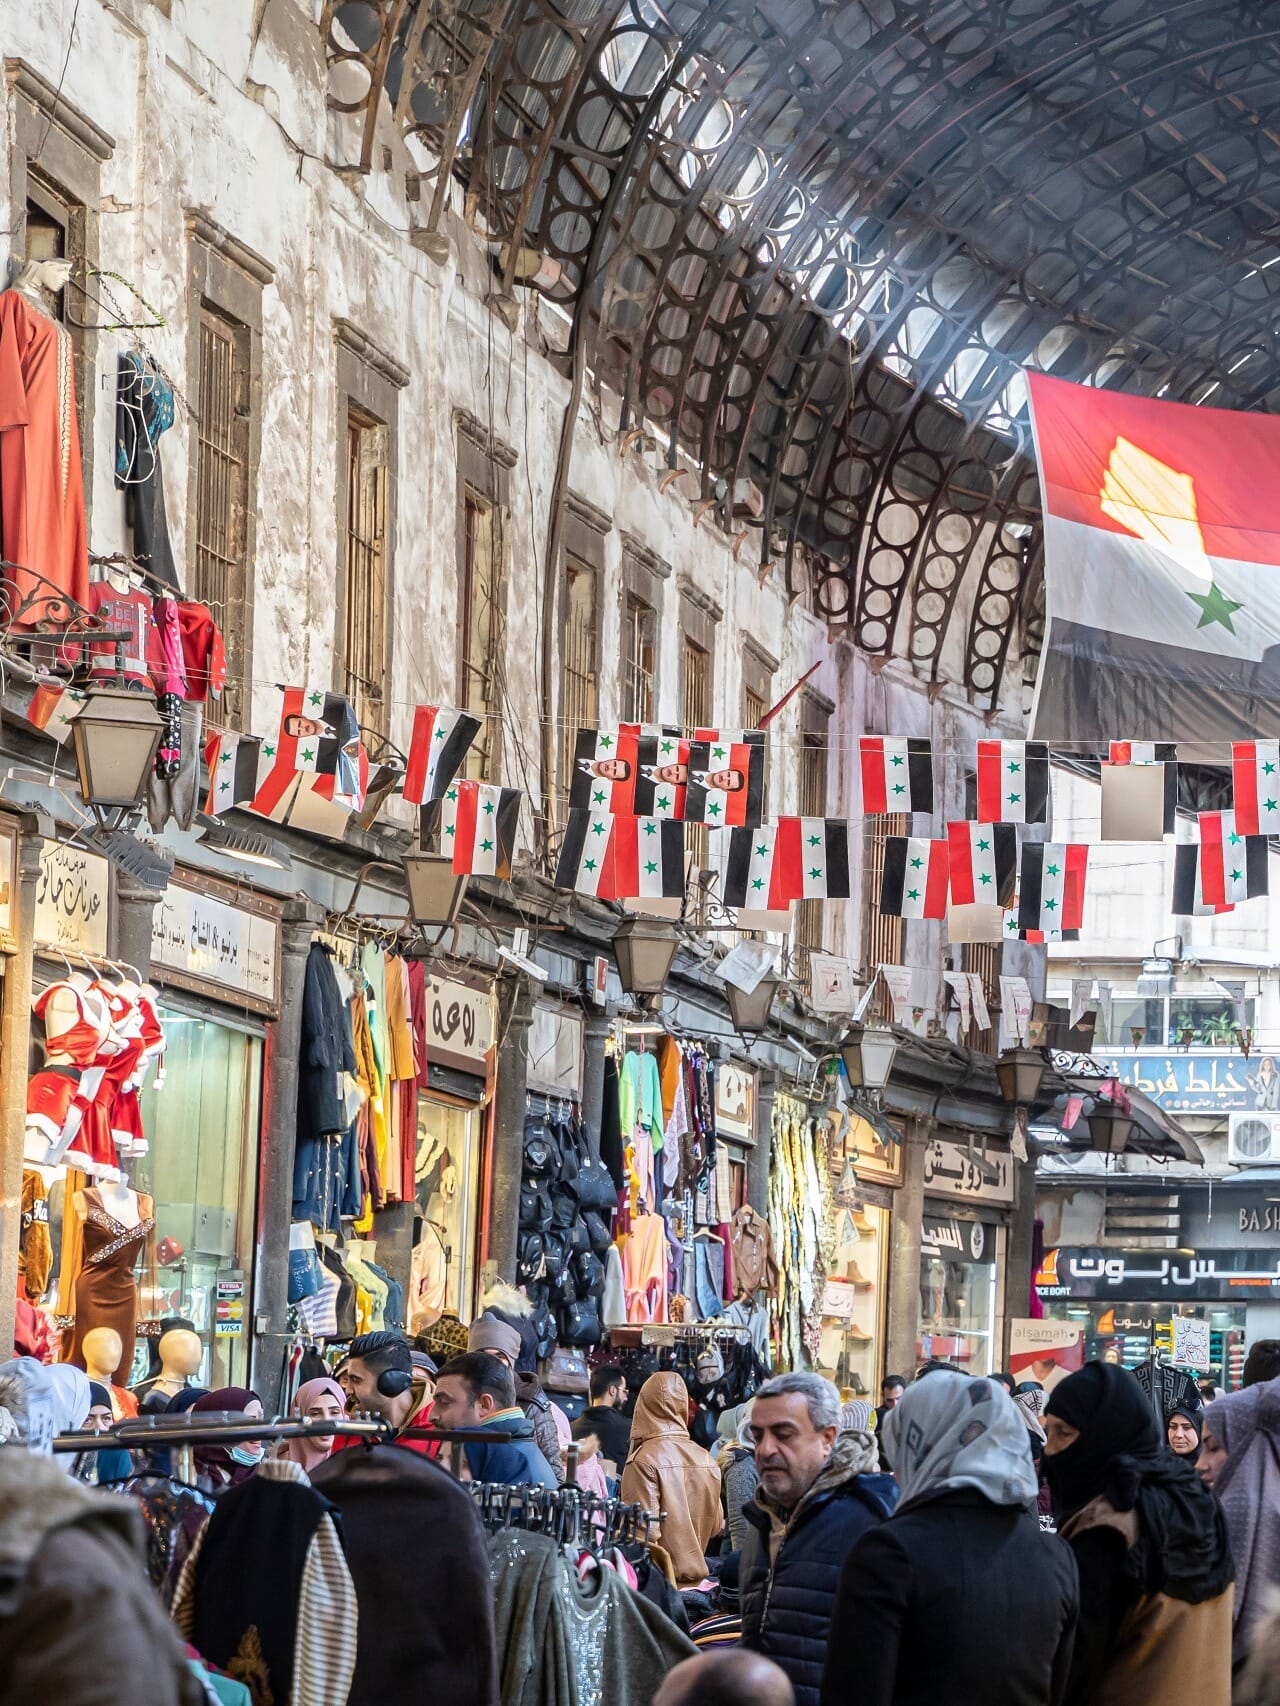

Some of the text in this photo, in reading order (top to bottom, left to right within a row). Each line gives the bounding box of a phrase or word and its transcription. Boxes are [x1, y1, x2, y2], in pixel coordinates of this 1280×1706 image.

[64, 877, 101, 922] عدنان
[432, 984, 475, 1047] روعة
[1185, 1060, 1248, 1098] خياط
[1069, 1257, 1169, 1286] بوت
[221, 1324, 240, 1332] VISA
